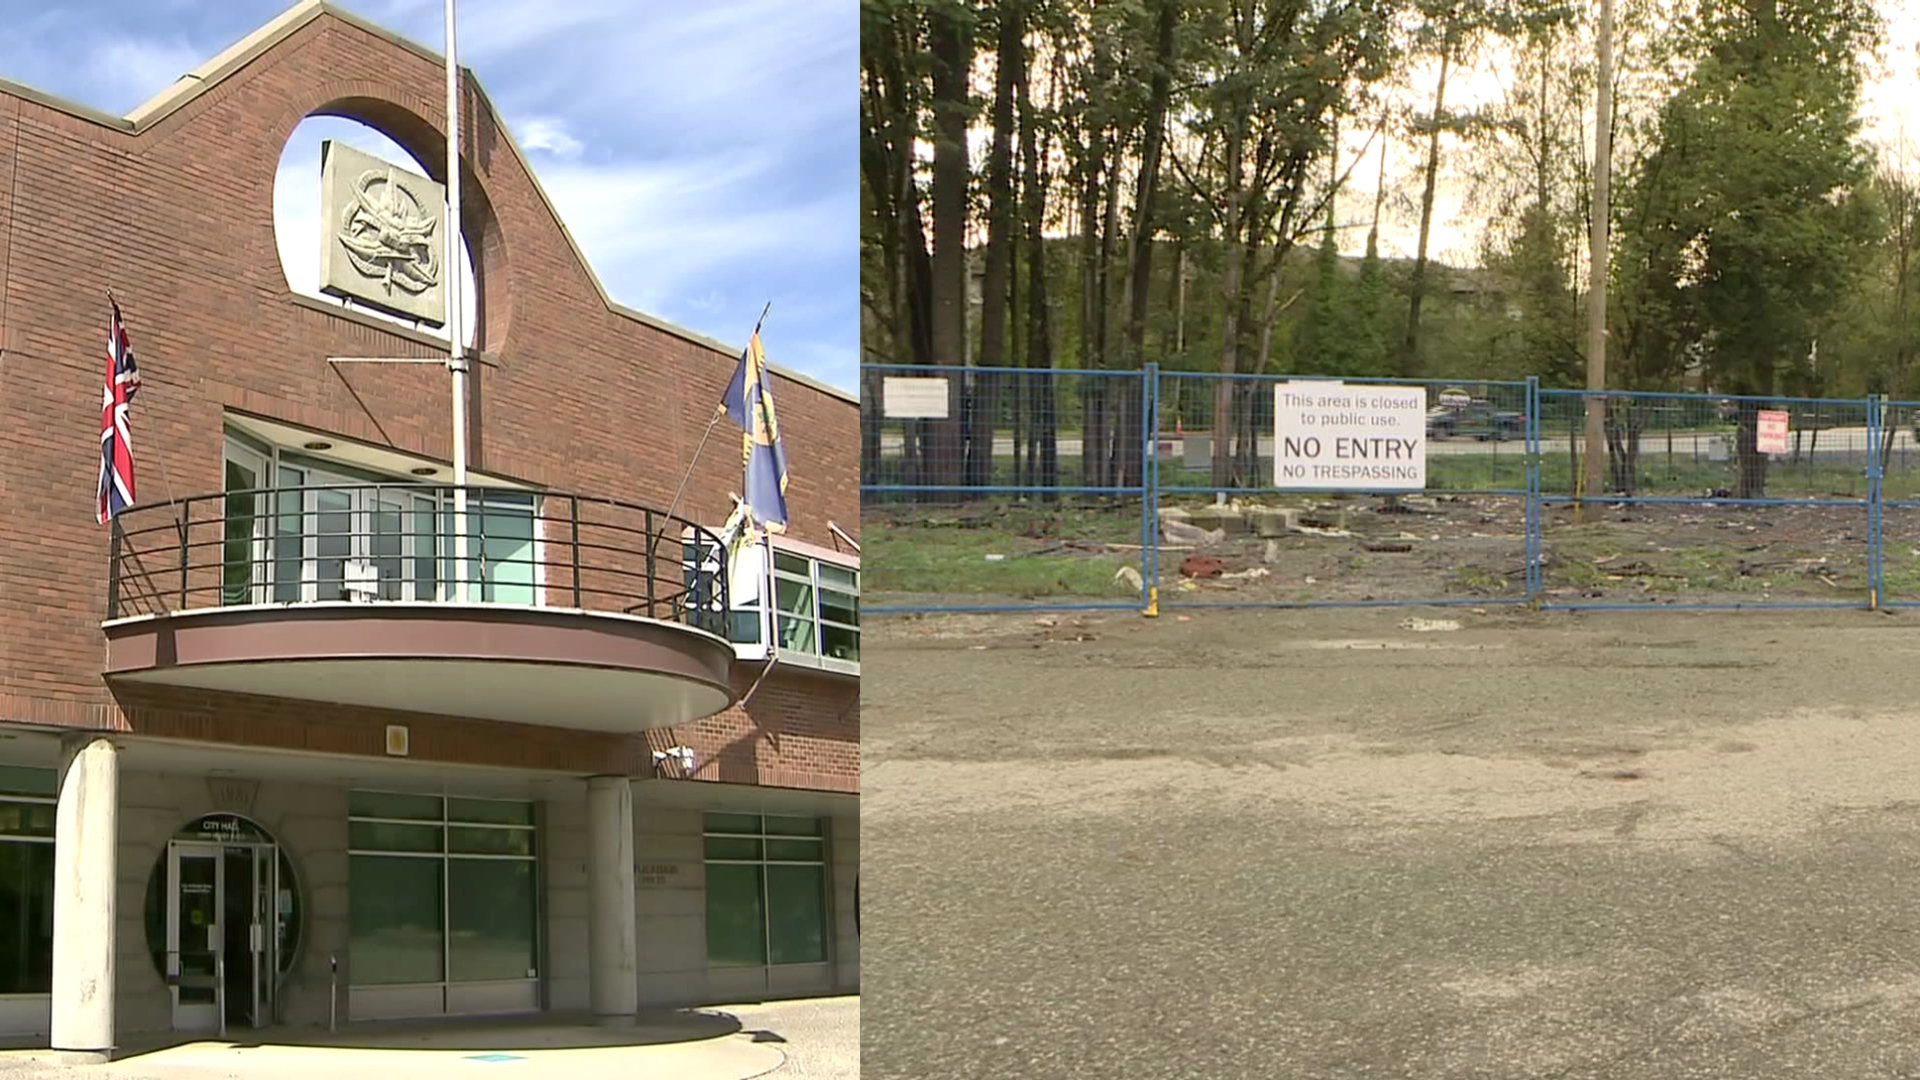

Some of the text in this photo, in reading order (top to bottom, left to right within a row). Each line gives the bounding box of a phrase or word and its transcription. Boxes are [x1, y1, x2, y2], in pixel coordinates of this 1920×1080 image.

[1283, 393, 1418, 409] This area is closed
[1301, 412, 1401, 427] to public use.
[1284, 437, 1418, 460] NO ENTRY
[1283, 465, 1418, 480] NO TRESPASSING
[202, 821, 240, 831] CITY HALL
